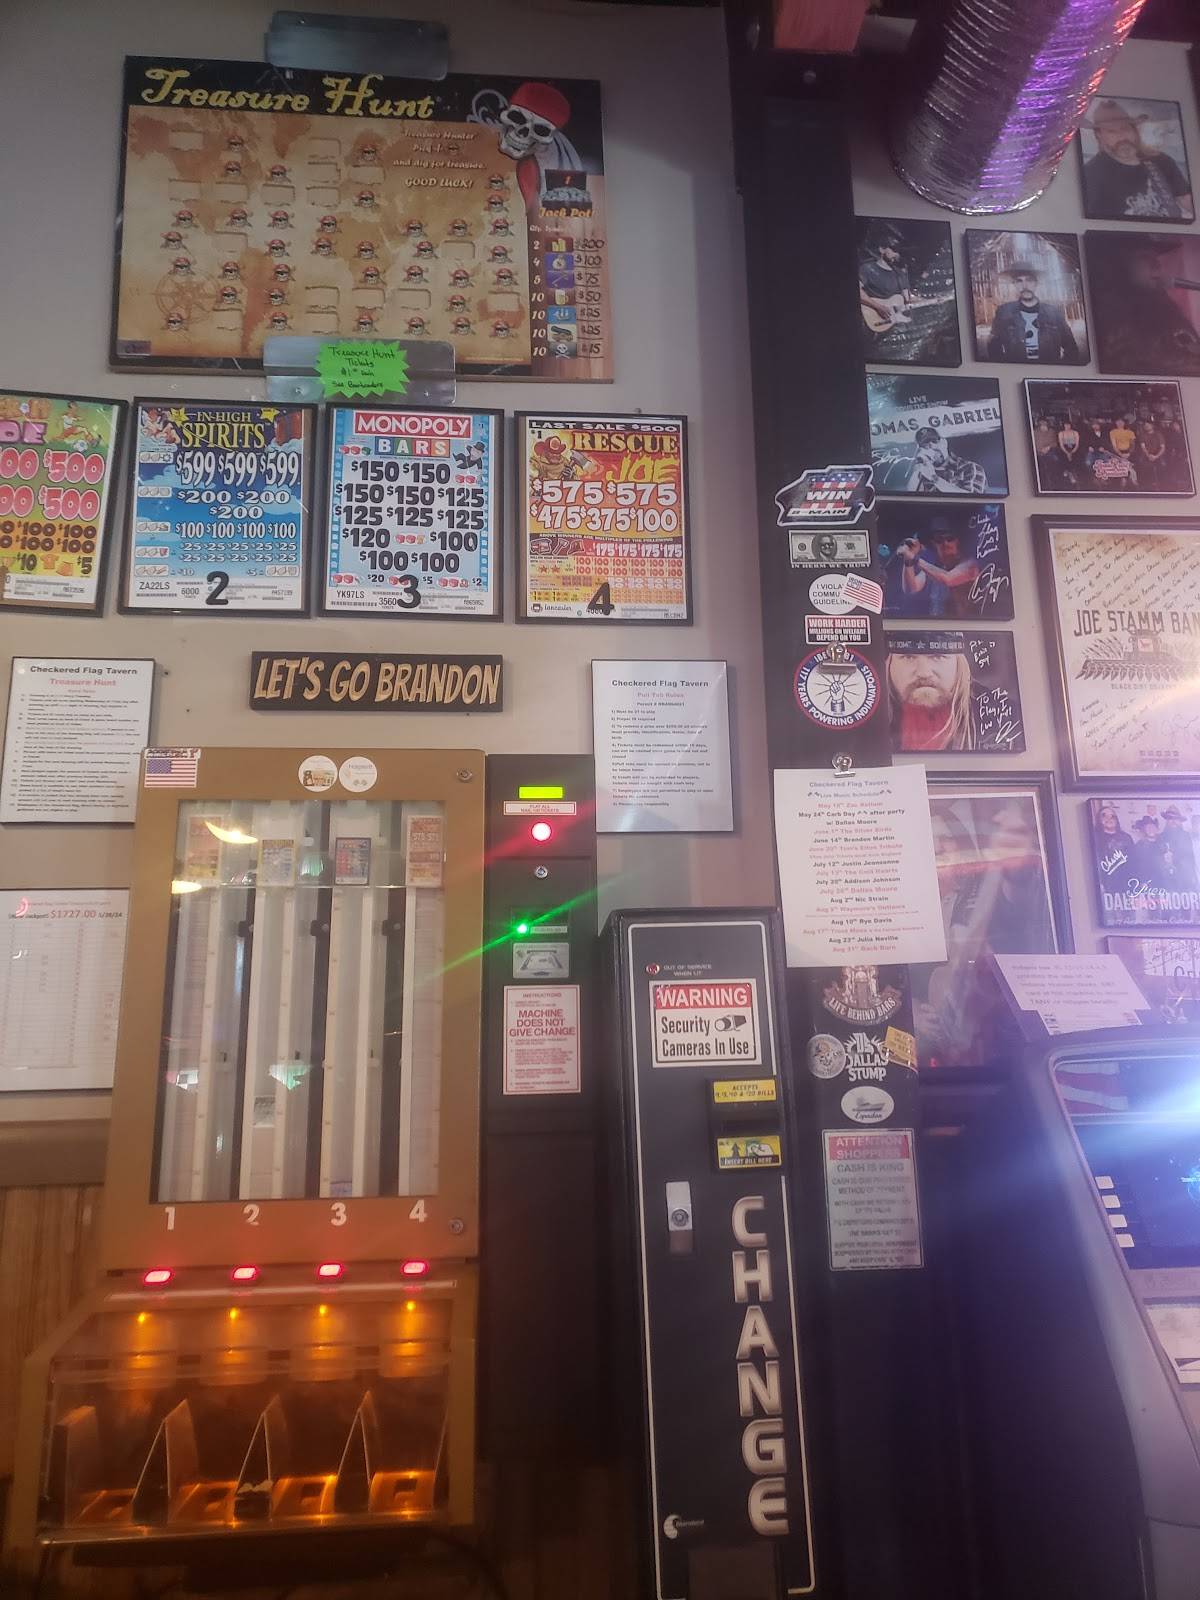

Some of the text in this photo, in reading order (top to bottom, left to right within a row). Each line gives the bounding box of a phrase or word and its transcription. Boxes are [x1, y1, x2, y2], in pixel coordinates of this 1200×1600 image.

[142, 68, 434, 119] Treasure Hunt
[405, 178, 474, 189] GOOD LUCK!
[533, 240, 541, 250] 2
[533, 256, 541, 267] 4
[574, 254, 602, 267] $100
[576, 272, 599, 285] $75
[532, 292, 545, 302] 10
[578, 292, 602, 303] $50
[532, 310, 546, 321] 10
[532, 328, 547, 338] 10
[372, 348, 396, 359] Hunt
[532, 346, 547, 356] 10
[908, 394, 928, 404] LIVE
[357, 415, 469, 436] MONOPOLY
[531, 421, 678, 433] LAST SALE $500
[871, 407, 1001, 436] OMAS GABRIEL
[182, 423, 266, 449] SPIRITS
[574, 432, 678, 454] RESCUE
[378, 438, 447, 455] BARS
[43, 448, 105, 485] $500
[176, 450, 299, 487] $599 $599 $599
[352, 460, 451, 484] $150 $150
[606, 451, 680, 484] JOE
[38, 485, 100, 521] $500
[177, 490, 291, 505] $200 $200
[336, 484, 485, 508] $150 $150 $125
[532, 479, 678, 507] $575 $575
[806, 490, 853, 501] WIN
[209, 505, 264, 520] $200
[335, 506, 485, 530] $125 $125 $125
[530, 504, 678, 532] $475 $375 $100
[17, 520, 97, 540] $100 $100
[176, 522, 297, 539] $100 $100 $100 $100
[342, 528, 478, 552] $120 $100
[16, 534, 95, 554] $100 $100
[17, 552, 93, 575] $10 $5
[360, 550, 460, 573] $100 $100
[139, 582, 170, 591] ZA22LS
[206, 571, 230, 606] 2
[368, 574, 482, 586] $20 $5 $2
[337, 590, 365, 599] YK97LS
[378, 597, 397, 606] 3560
[398, 574, 422, 609] 3
[587, 582, 615, 616] 4
[809, 618, 867, 628] WORK HARDER
[1074, 610, 1165, 637] JOE STAMM
[816, 634, 861, 642] DEPEND ON YOU
[30, 665, 81, 675] Checkered
[82, 666, 104, 676] Flag
[254, 656, 501, 705] LET'S GO BRANDON
[660, 680, 678, 688] Flag
[798, 664, 877, 726] YEARS POWERING INDIANAPOLIS
[1104, 892, 1158, 912] DALLAS
[50, 910, 97, 919] $1727.00
[659, 987, 749, 1008] WARNING
[518, 1009, 564, 1018] MACHINE
[828, 997, 896, 1021] LIFE BEHIND BARS
[509, 1027, 576, 1037] GIVE CHANGE
[516, 1018, 566, 1028] DOES NOT
[661, 1015, 711, 1036] Security
[662, 1037, 750, 1058] Cameras In Use
[846, 1052, 889, 1069] DALLAS
[848, 1067, 887, 1081] STUMP
[836, 1136, 903, 1147] ATTENTION
[837, 1162, 905, 1173] CASH IS KING
[164, 1206, 176, 1231] 1
[243, 1204, 260, 1226] 2
[330, 1202, 347, 1226] 3
[409, 1200, 428, 1223] 4
[732, 1195, 790, 1537] CHANGE
